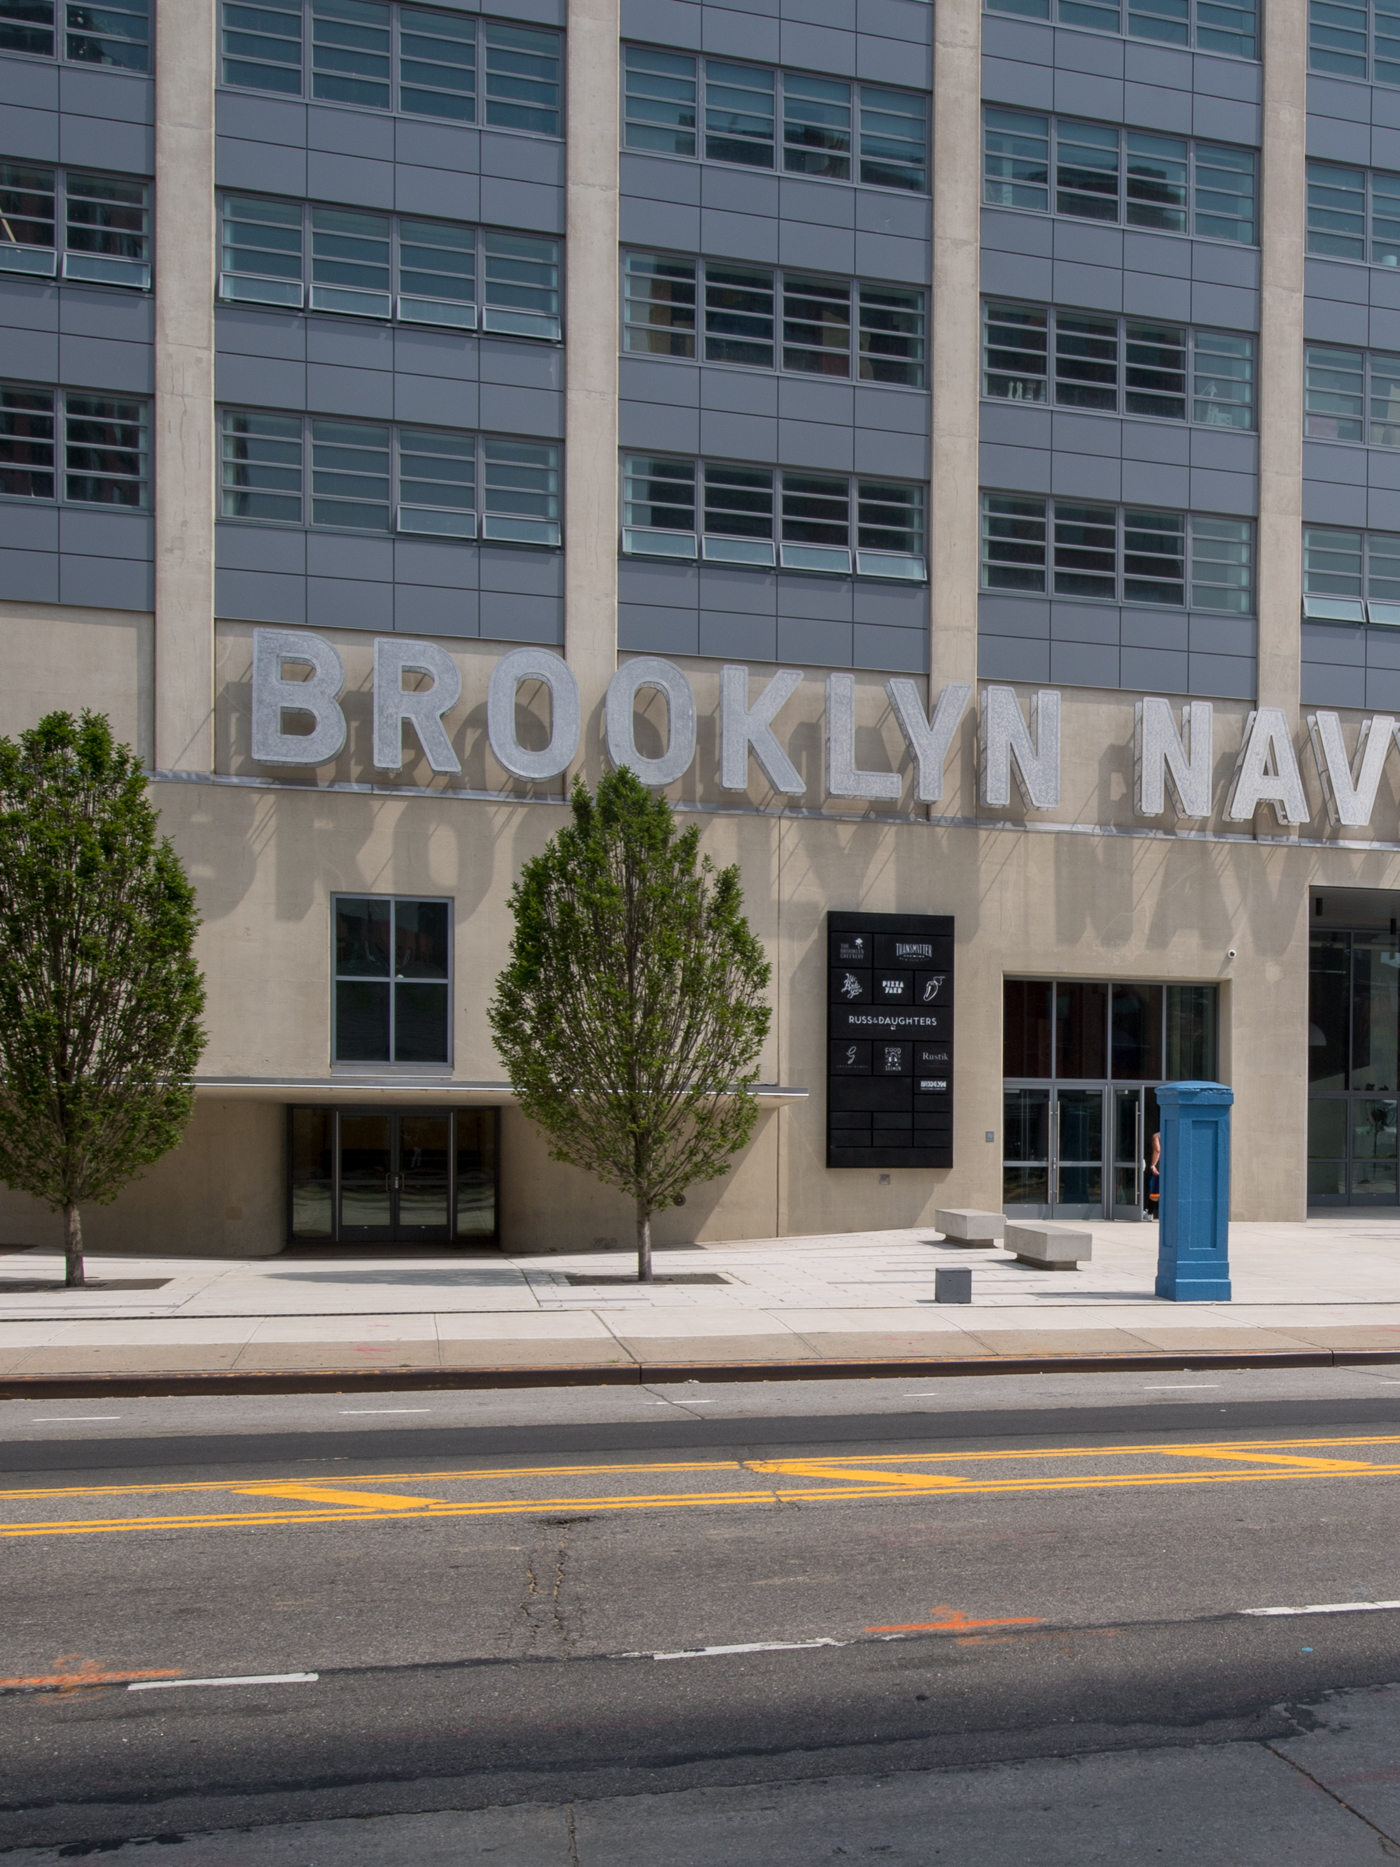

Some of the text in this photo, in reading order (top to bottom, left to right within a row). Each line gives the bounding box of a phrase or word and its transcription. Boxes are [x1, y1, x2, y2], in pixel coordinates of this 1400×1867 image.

[252, 627, 1062, 811] BROOKLYN
[896, 943, 933, 957] TRANSMITTER
[884, 1047, 902, 1055] FOOD
[922, 1052, 948, 1060] Rustik
